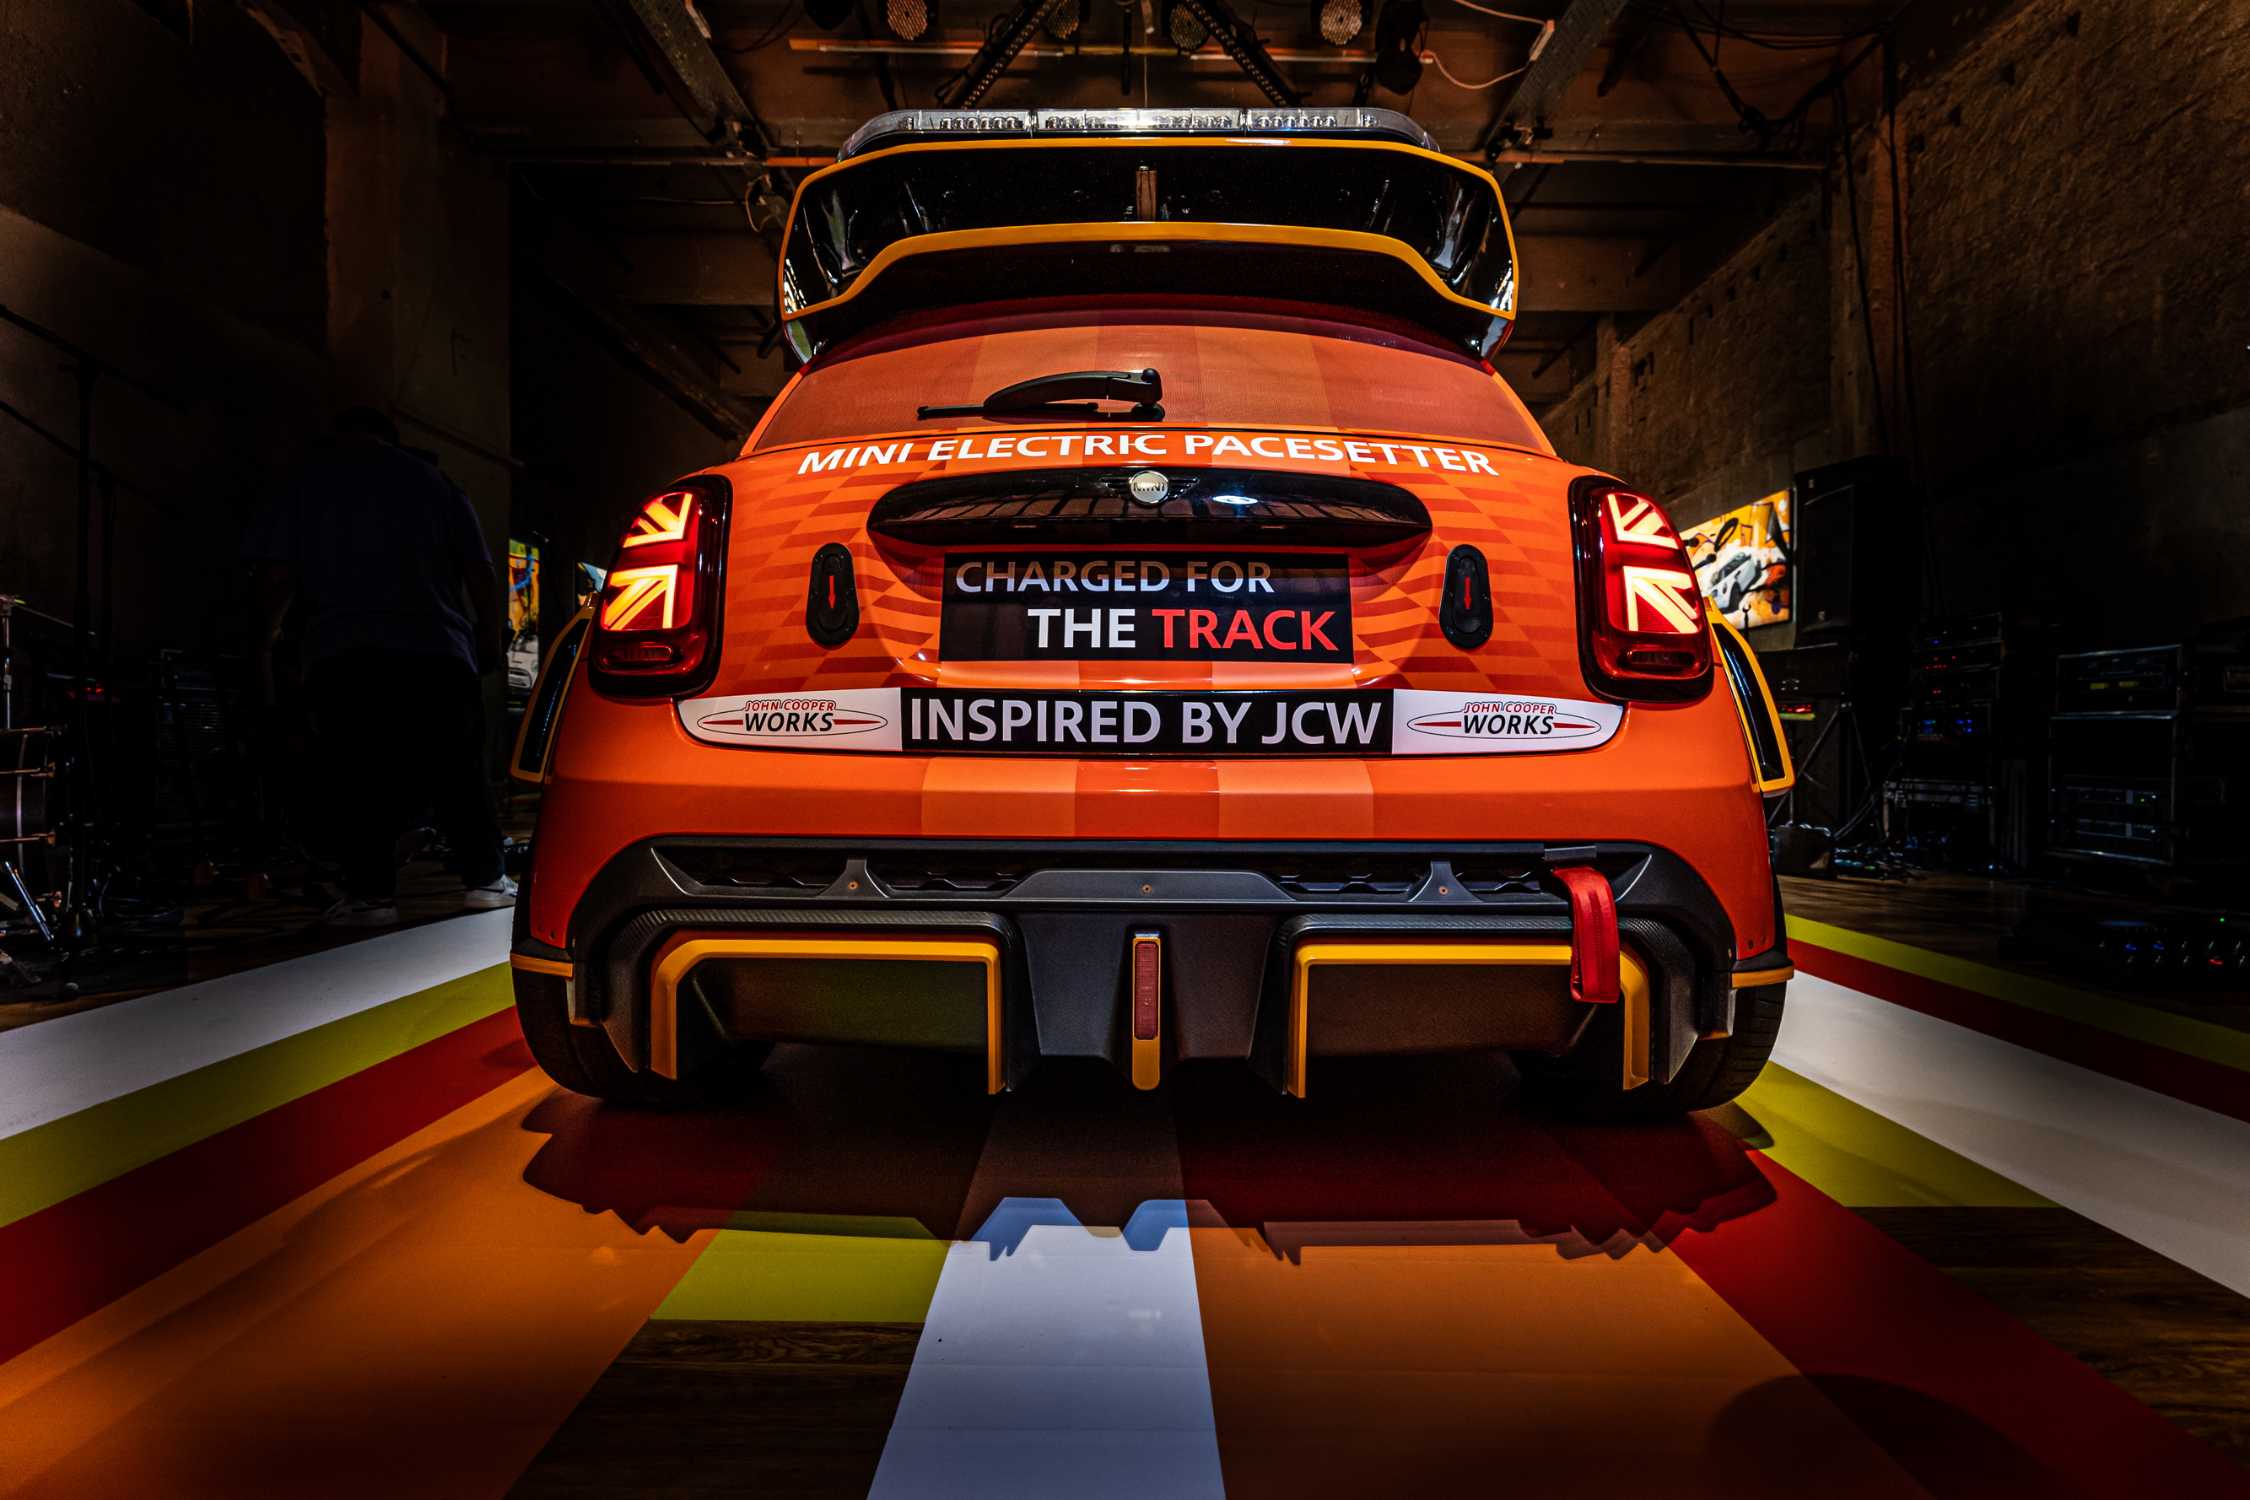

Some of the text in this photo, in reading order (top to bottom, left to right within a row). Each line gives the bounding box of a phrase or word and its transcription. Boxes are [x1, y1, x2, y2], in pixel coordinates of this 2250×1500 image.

[797, 434, 1499, 477] MINI ELECTRIC PACESETTER
[1133, 482, 1165, 492] MINI
[955, 561, 1275, 593] CHARGED FOR
[1027, 608, 1339, 651] THE TRACK
[744, 701, 835, 712] JOHN COOPER
[1464, 702, 1556, 715] JOHN COOPER
[743, 712, 834, 732] WORKS
[911, 698, 1382, 745] INSPIRED BY JCW
[1463, 715, 1555, 735] WORKS
